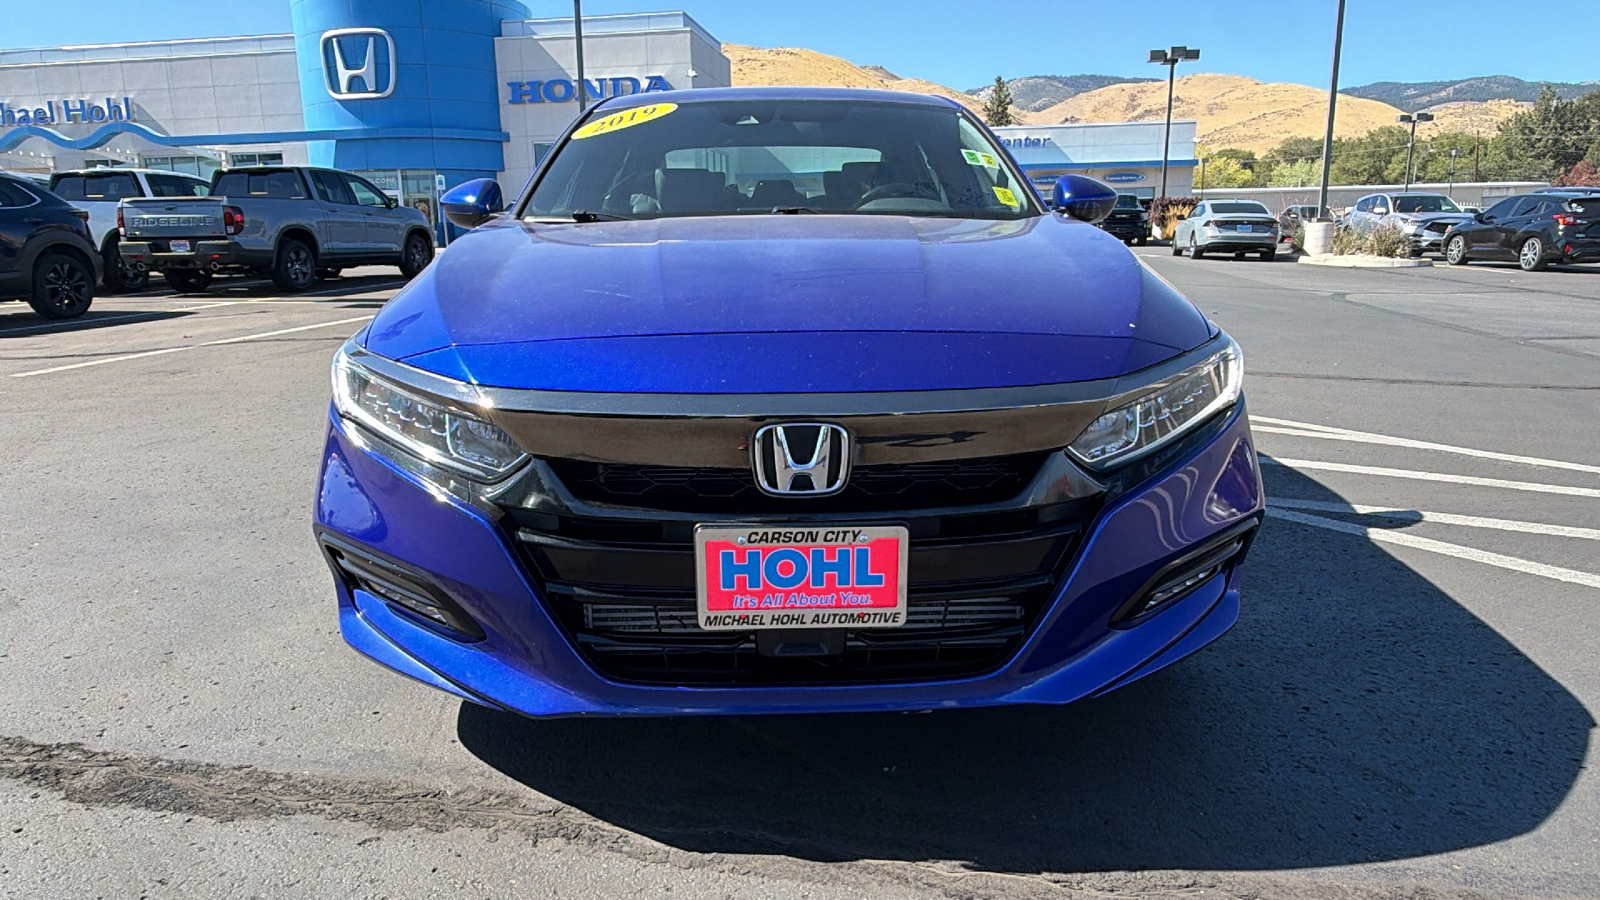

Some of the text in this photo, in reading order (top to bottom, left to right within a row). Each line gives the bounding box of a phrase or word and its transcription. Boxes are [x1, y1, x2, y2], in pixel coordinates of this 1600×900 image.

[507, 75, 676, 104] HONDA
[63, 97, 132, 123] Hohl
[592, 107, 657, 133] 2019
[132, 216, 214, 227] RIDGELINE
[747, 530, 863, 544] CARSON CITY
[720, 547, 884, 590] HOHL
[733, 592, 873, 608] It's All About You.
[704, 611, 901, 627] MICHAEL HOHL AUTOMOTIVE
